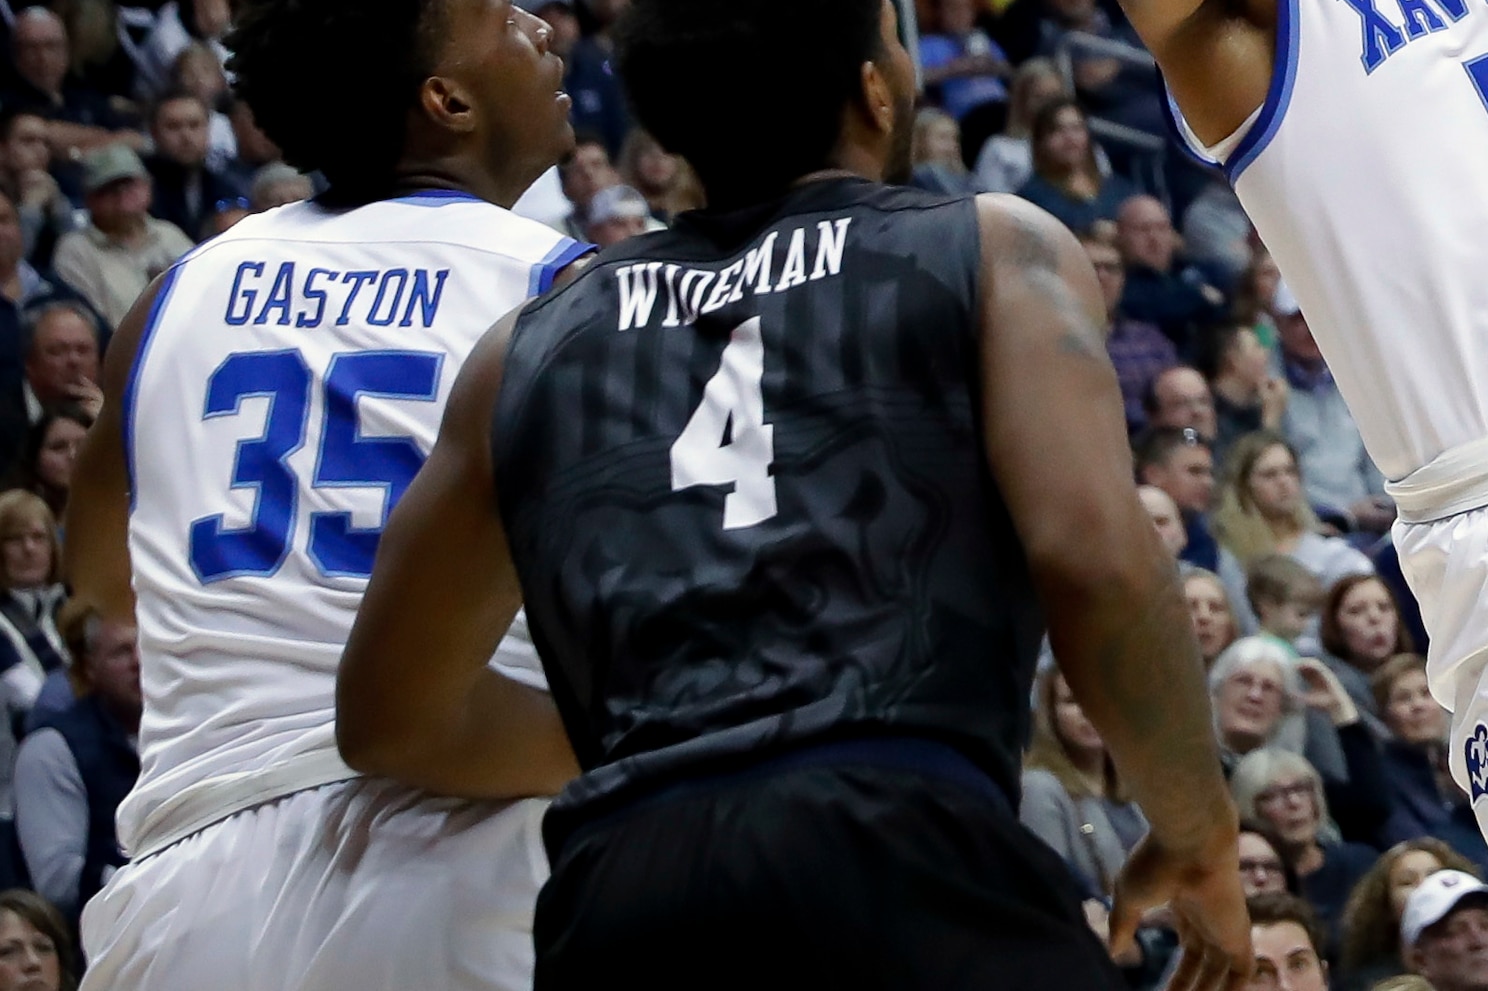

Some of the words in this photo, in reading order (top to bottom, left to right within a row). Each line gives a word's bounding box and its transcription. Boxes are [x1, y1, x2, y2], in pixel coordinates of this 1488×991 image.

[225, 260, 450, 329] GASTON
[615, 216, 853, 332] WIDEMAN
[188, 347, 447, 586] 35
[669, 315, 778, 530] 4
